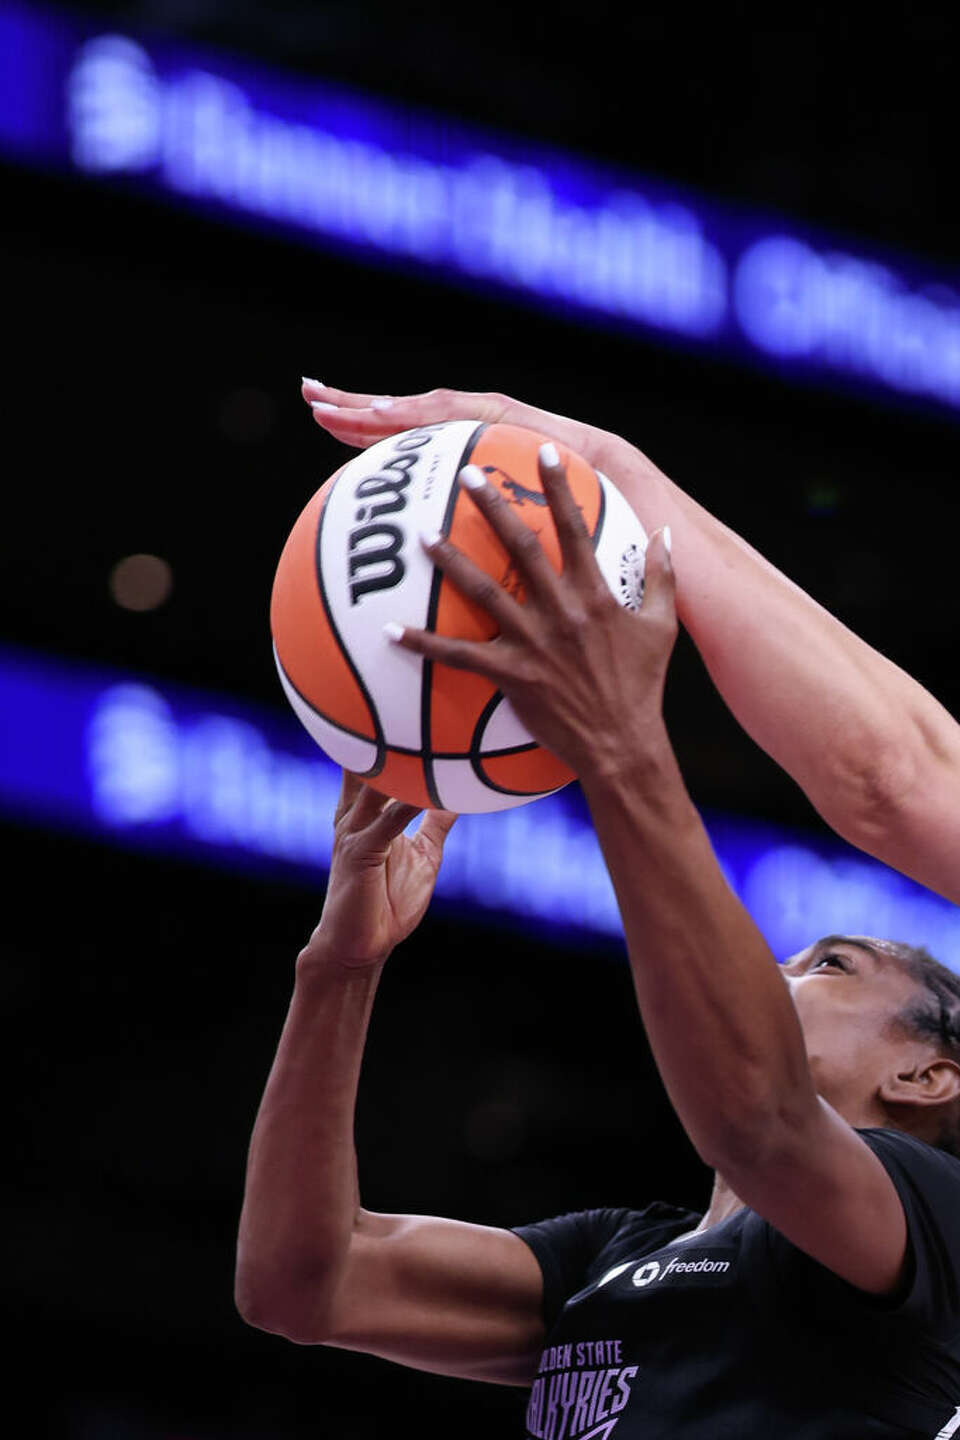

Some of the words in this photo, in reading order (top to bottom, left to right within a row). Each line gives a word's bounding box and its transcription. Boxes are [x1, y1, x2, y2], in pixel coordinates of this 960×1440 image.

[346, 428, 442, 607] Wilso
[658, 1257, 730, 1281] freedom
[576, 1338, 623, 1367] STATE
